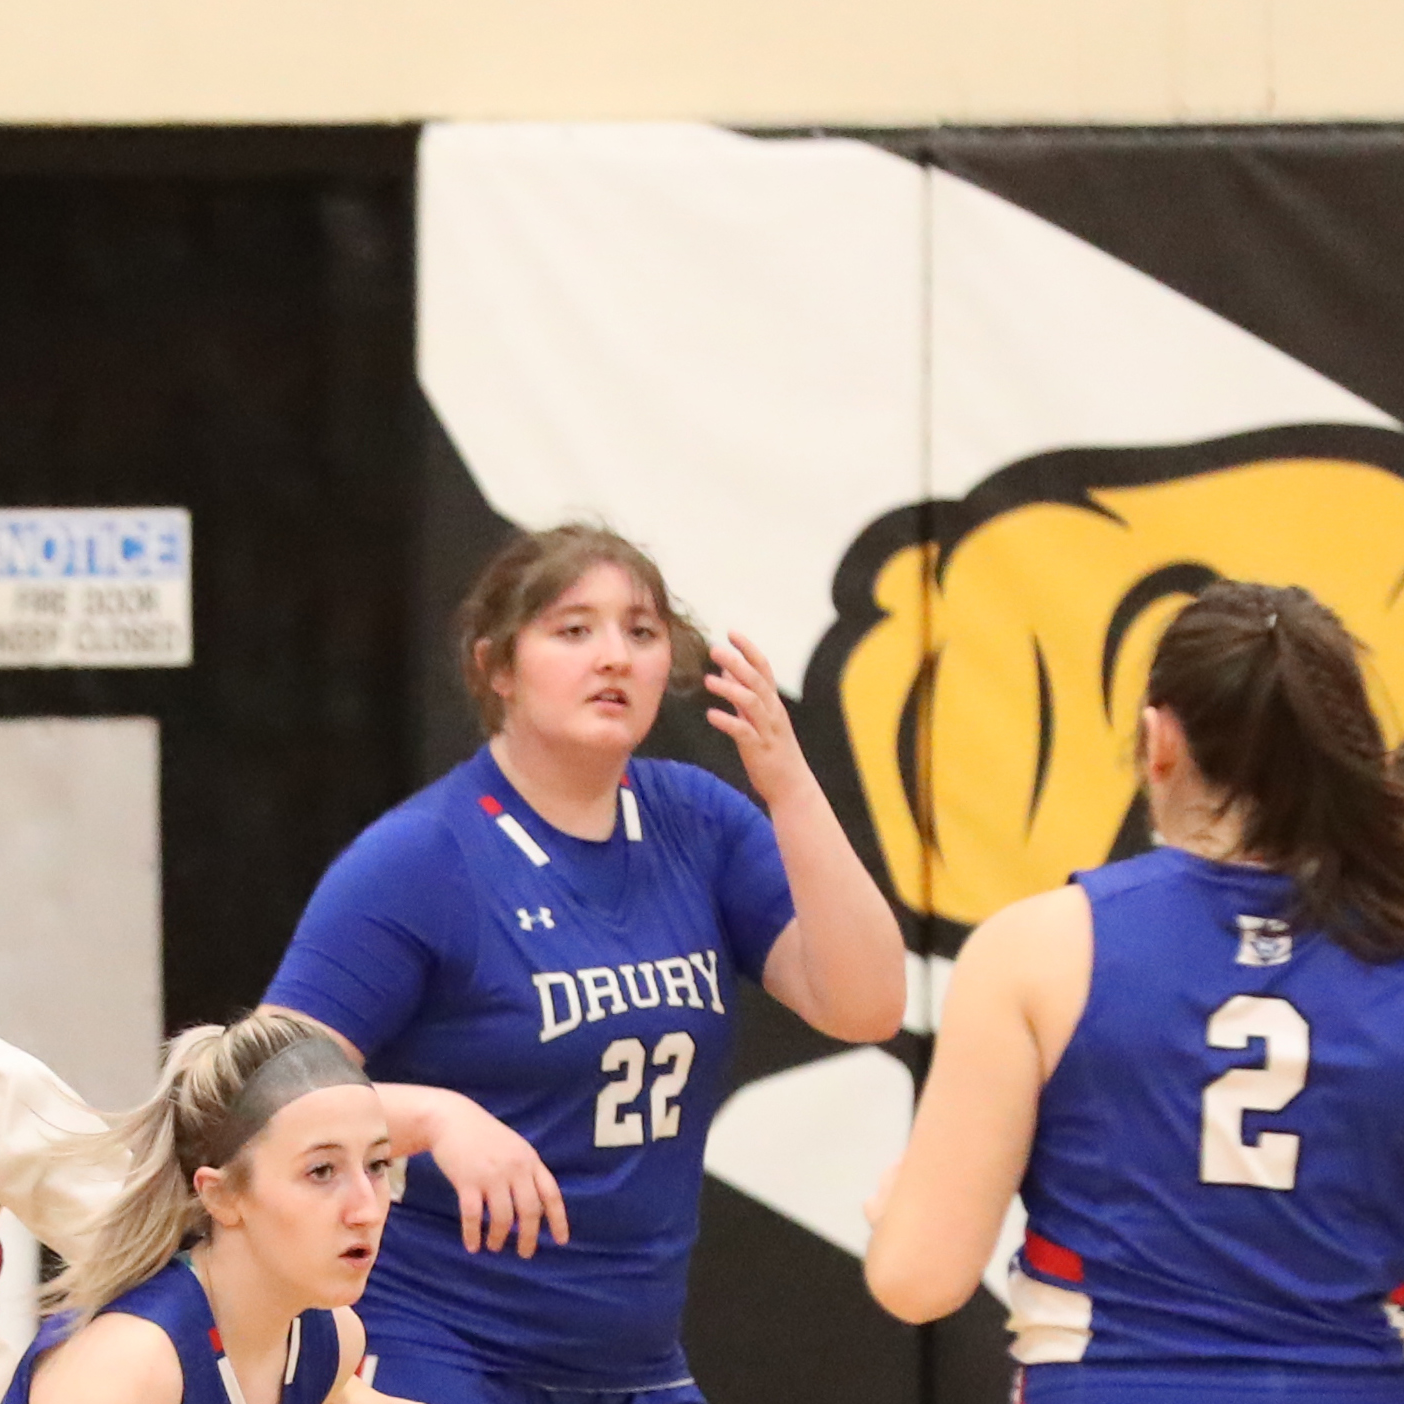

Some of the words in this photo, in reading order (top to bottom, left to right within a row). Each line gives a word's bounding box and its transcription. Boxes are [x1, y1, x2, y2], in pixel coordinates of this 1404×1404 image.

[531, 949, 726, 1044] DRURY
[594, 1030, 696, 1148] 22
[1200, 994, 1310, 1191] 2
